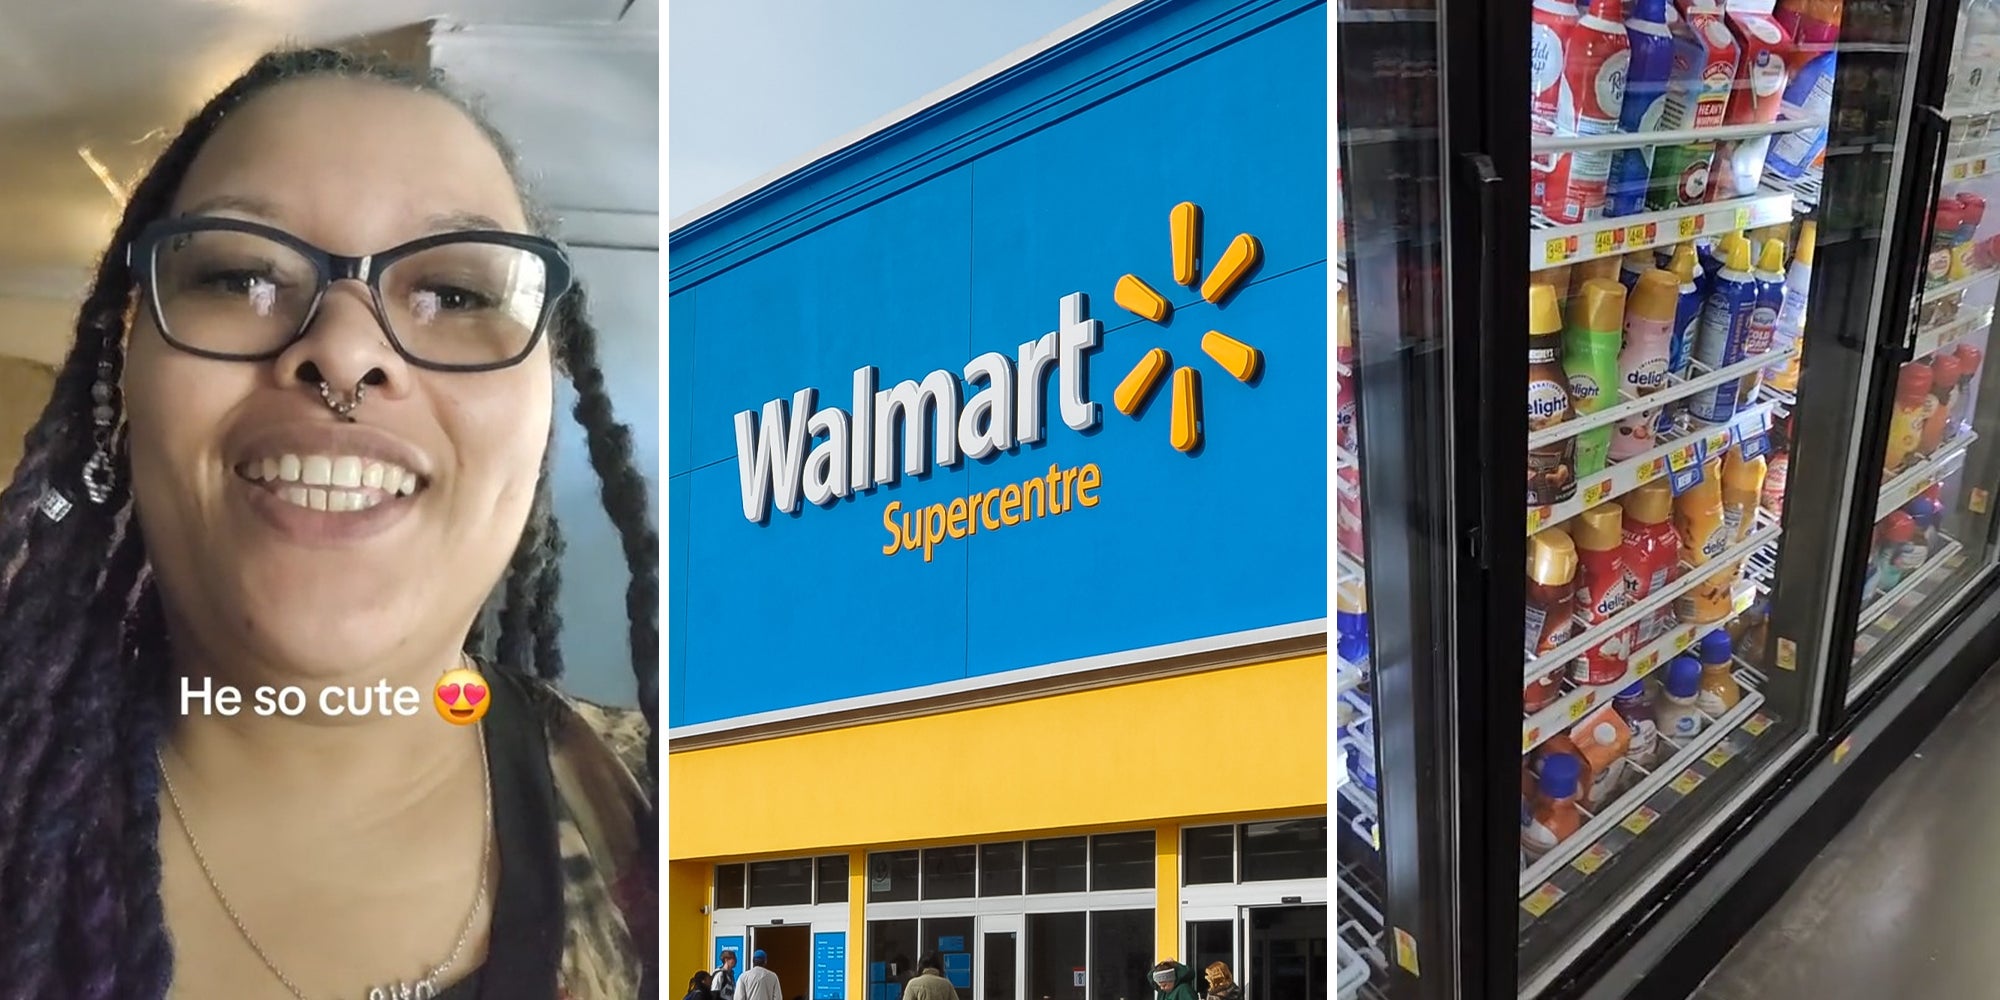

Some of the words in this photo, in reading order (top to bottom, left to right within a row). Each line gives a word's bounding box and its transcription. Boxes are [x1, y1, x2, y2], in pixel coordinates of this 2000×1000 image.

[1698, 103, 1723, 115] HEAVY
[1569, 383, 1600, 398] elight
[734, 291, 1097, 523] Walmart
[1528, 394, 1567, 418] elight
[882, 463, 1101, 562] Supercentre
